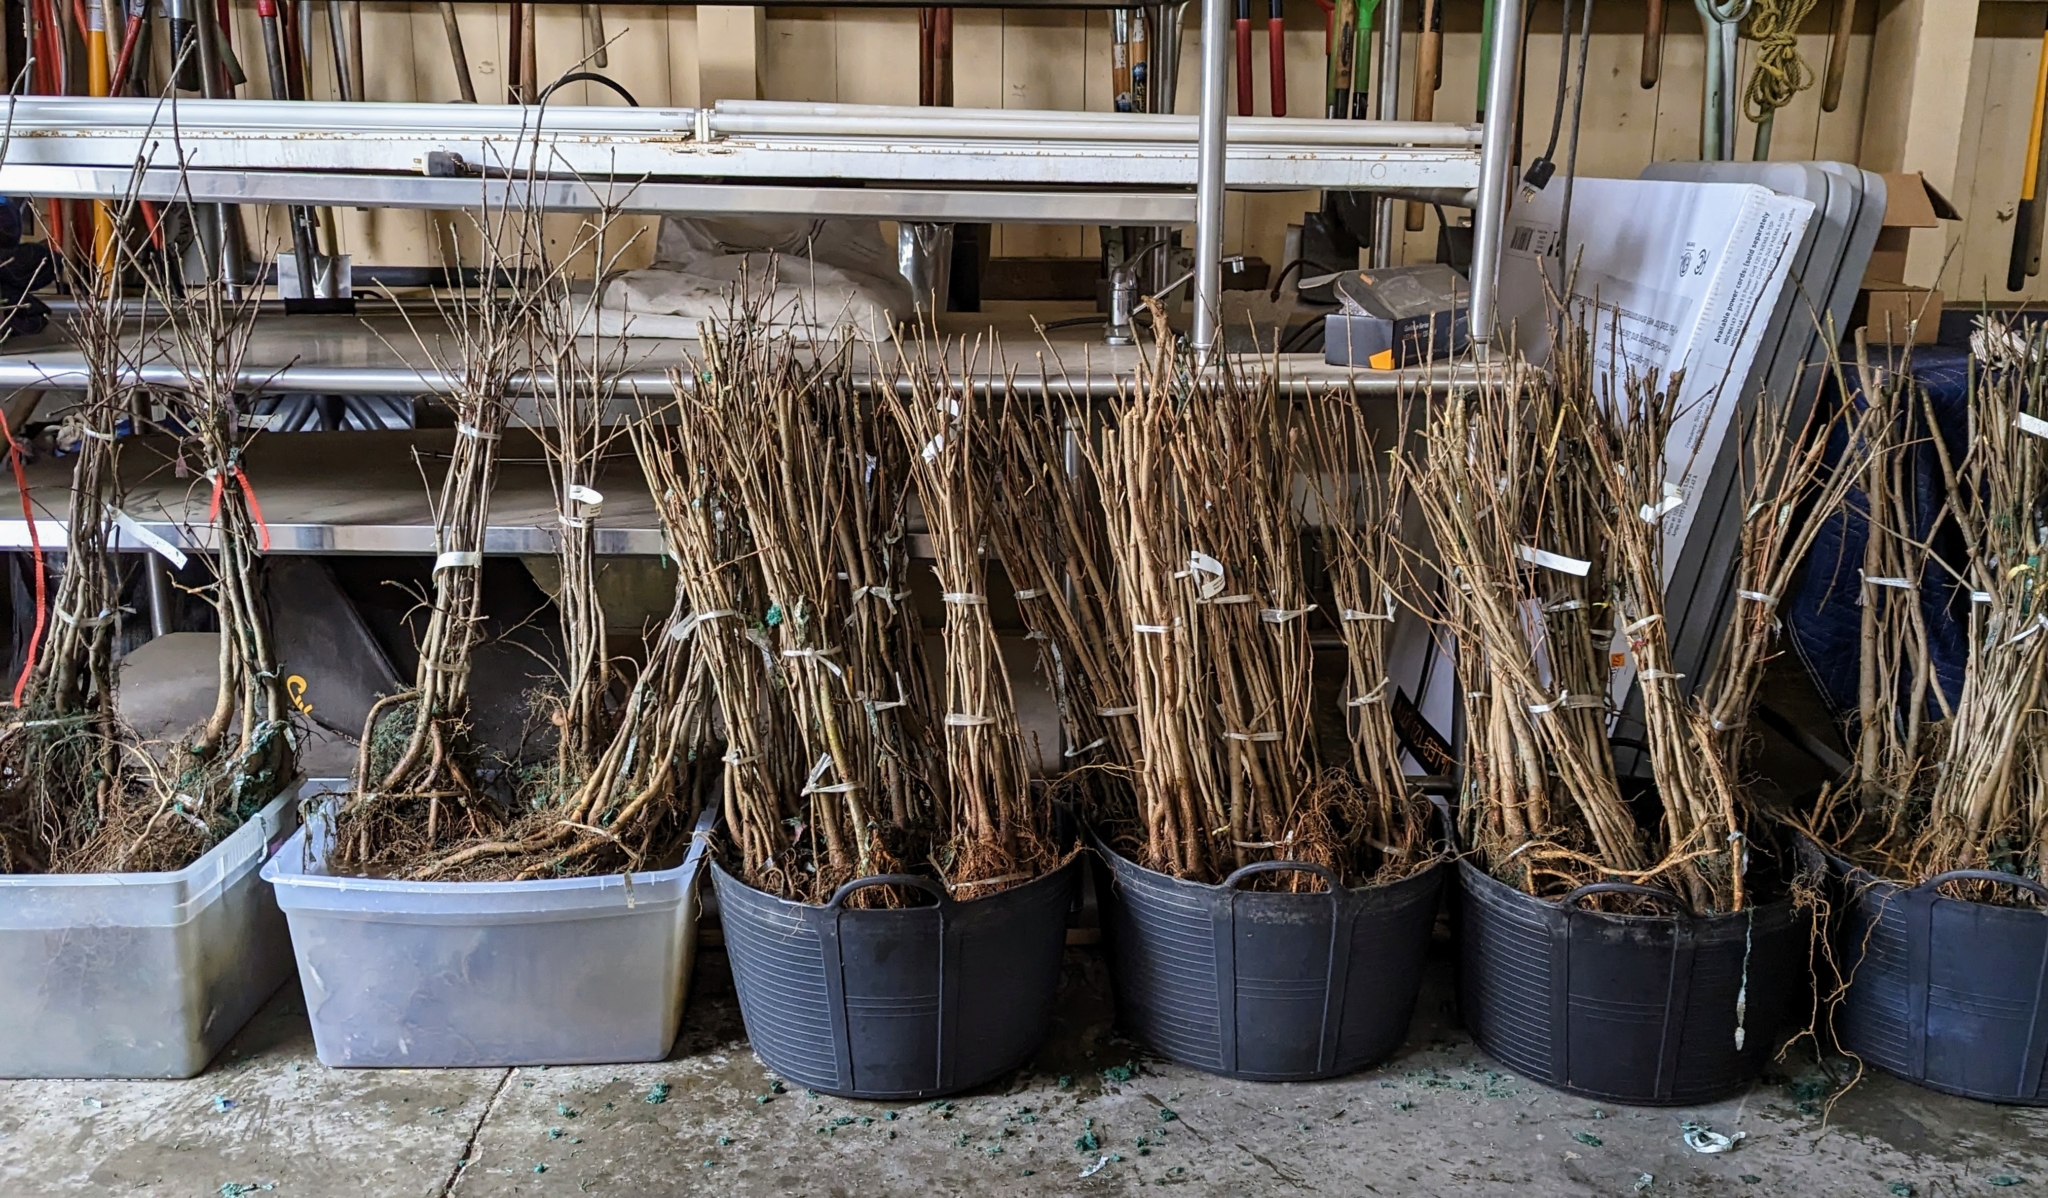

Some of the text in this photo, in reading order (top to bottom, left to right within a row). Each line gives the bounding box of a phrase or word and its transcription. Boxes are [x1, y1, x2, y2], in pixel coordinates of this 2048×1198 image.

[1714, 312, 1730, 343] Available
[1727, 289, 1738, 312] power
[1735, 267, 1748, 289] cords:
[1751, 212, 1770, 248] separately
[1742, 278, 1752, 294] Power
[1748, 265, 1758, 278] Cord
[1749, 280, 1759, 296] Power
[1755, 267, 1765, 280] Cord
